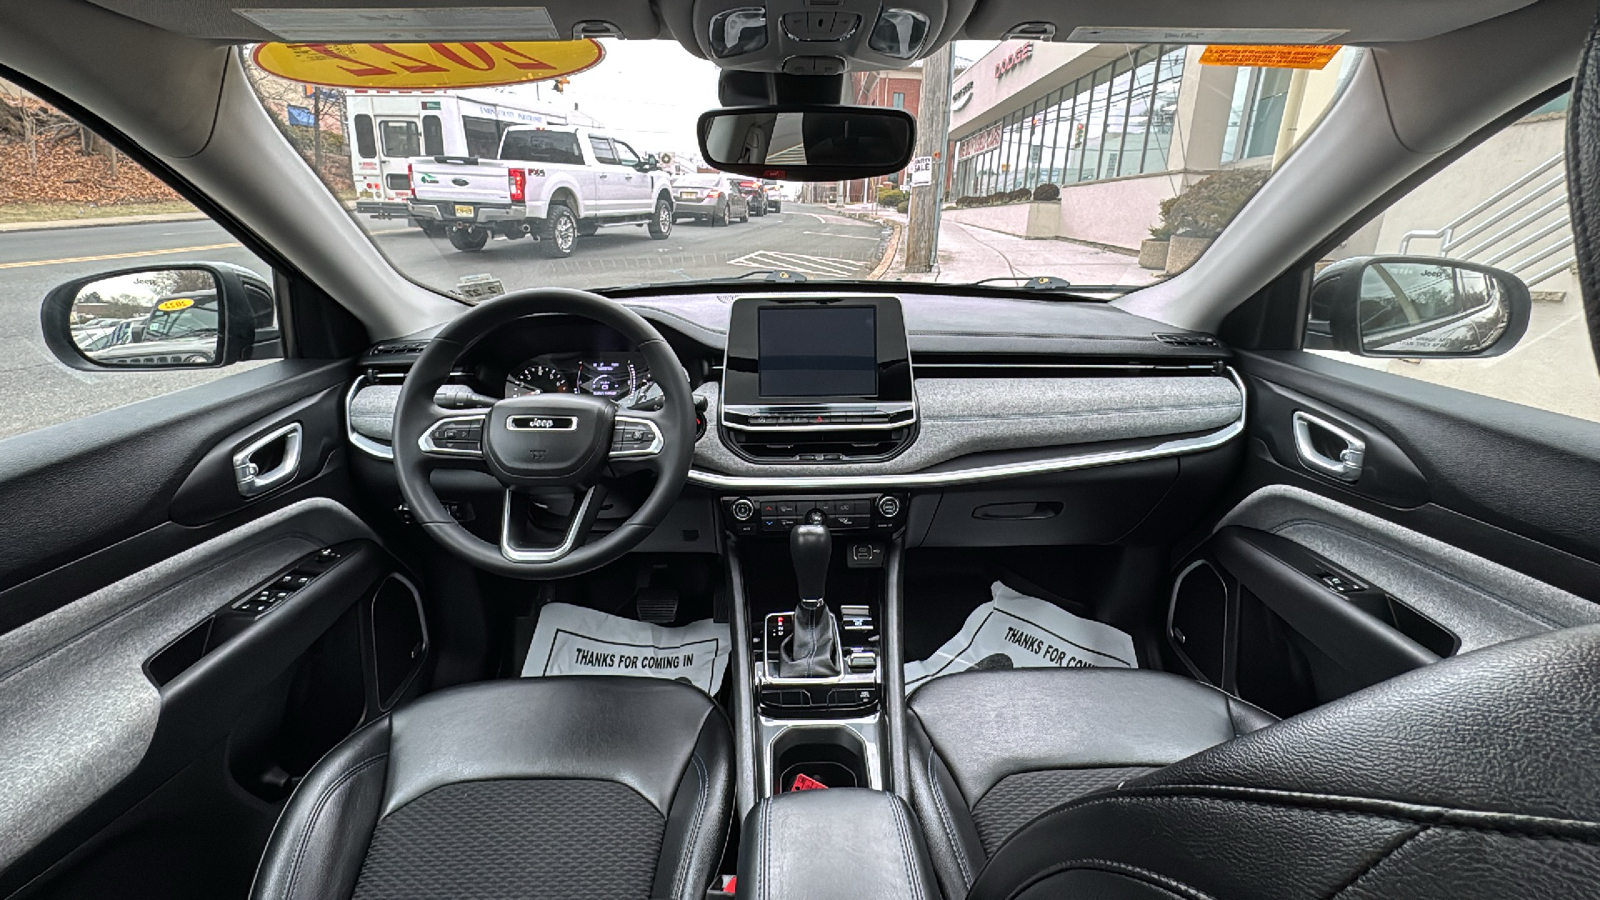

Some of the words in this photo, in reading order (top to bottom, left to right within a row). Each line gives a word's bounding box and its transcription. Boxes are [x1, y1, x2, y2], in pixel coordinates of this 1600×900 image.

[995, 41, 1032, 78] DODGE
[914, 163, 930, 172] SALE
[530, 418, 553, 428] Jeep
[1004, 626, 1044, 655] THANKS
[1043, 644, 1066, 667] FOR
[575, 648, 616, 667] THANKS
[618, 655, 639, 668] FOR
[641, 656, 680, 669] COMING
[683, 653, 694, 667] IN
